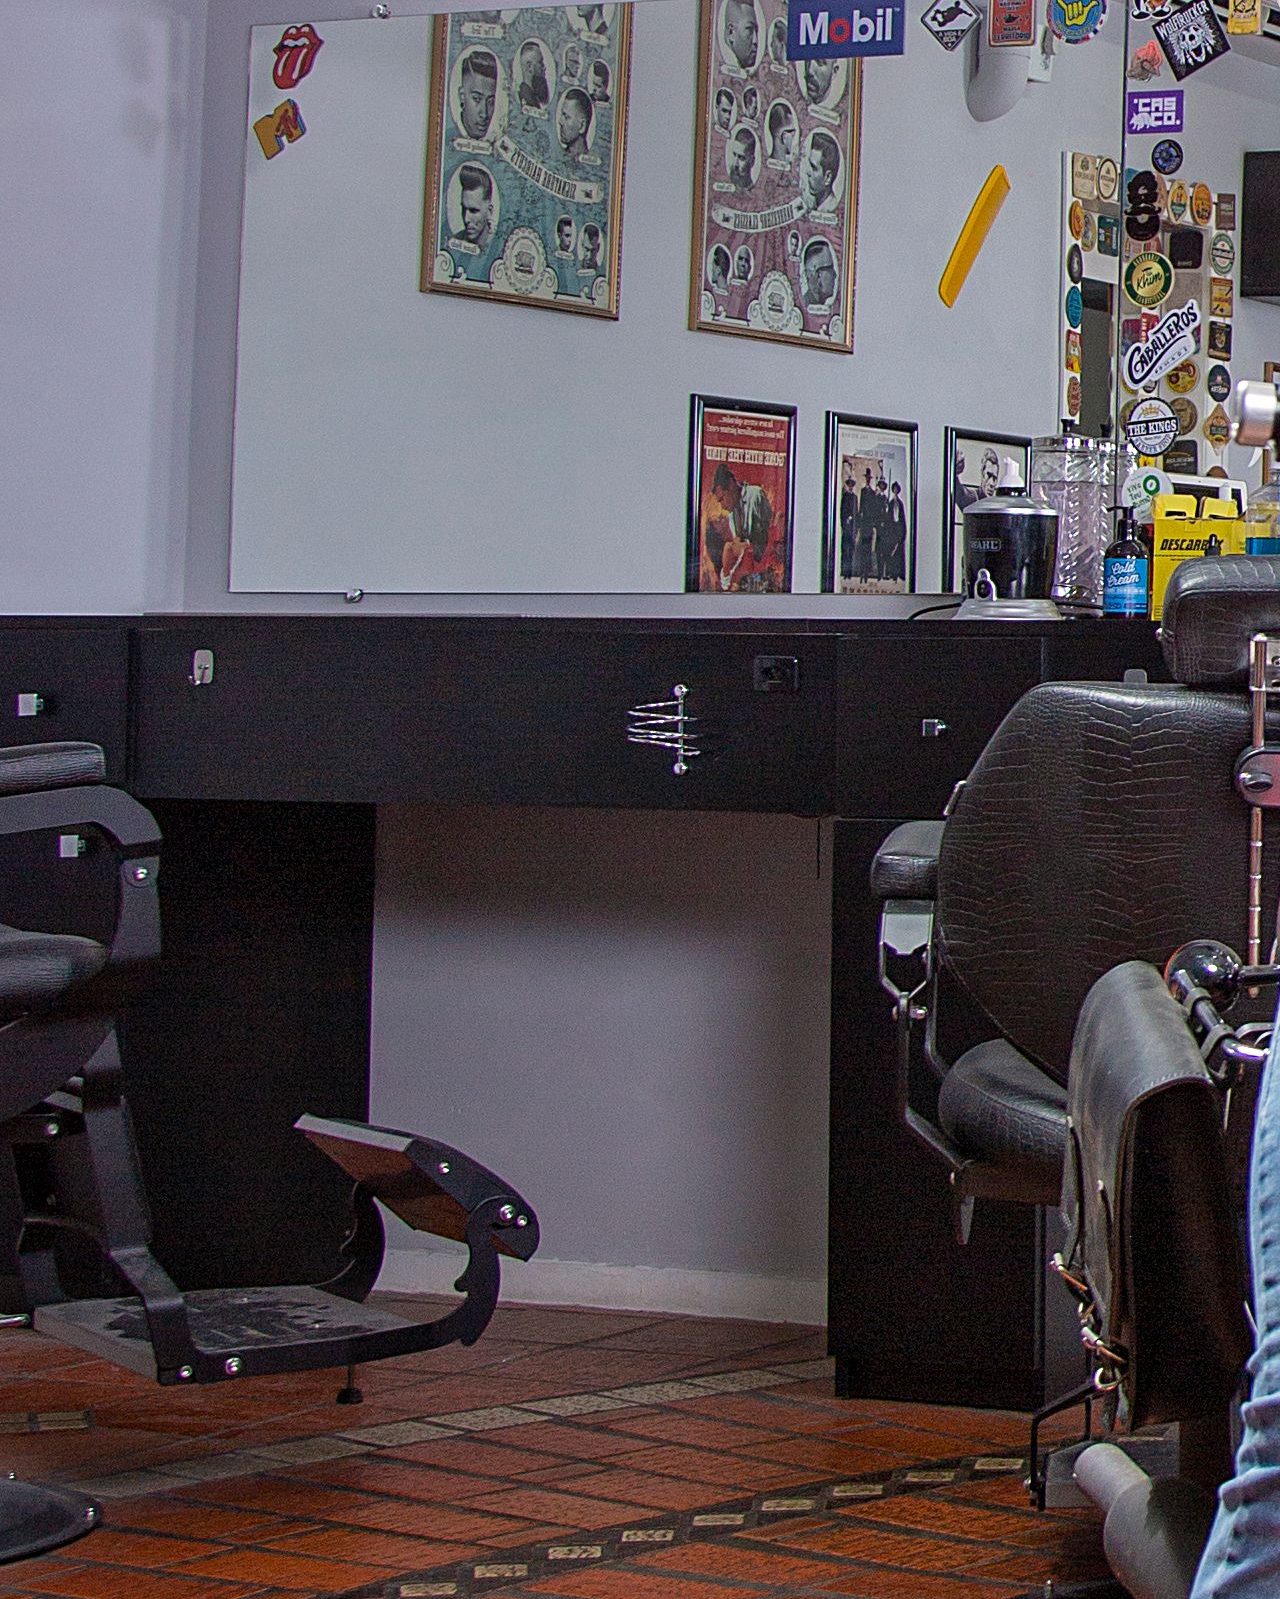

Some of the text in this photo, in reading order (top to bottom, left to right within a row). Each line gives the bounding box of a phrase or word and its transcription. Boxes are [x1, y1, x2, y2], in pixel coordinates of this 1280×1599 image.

[800, 8, 892, 46] Mobil
[1128, 302, 1198, 384] CABALLEROS
[1128, 419, 1177, 436] THE KINGS
[1160, 538, 1224, 551] DESCARBX
[1112, 560, 1136, 575] Cold
[1107, 573, 1140, 588] Cream
